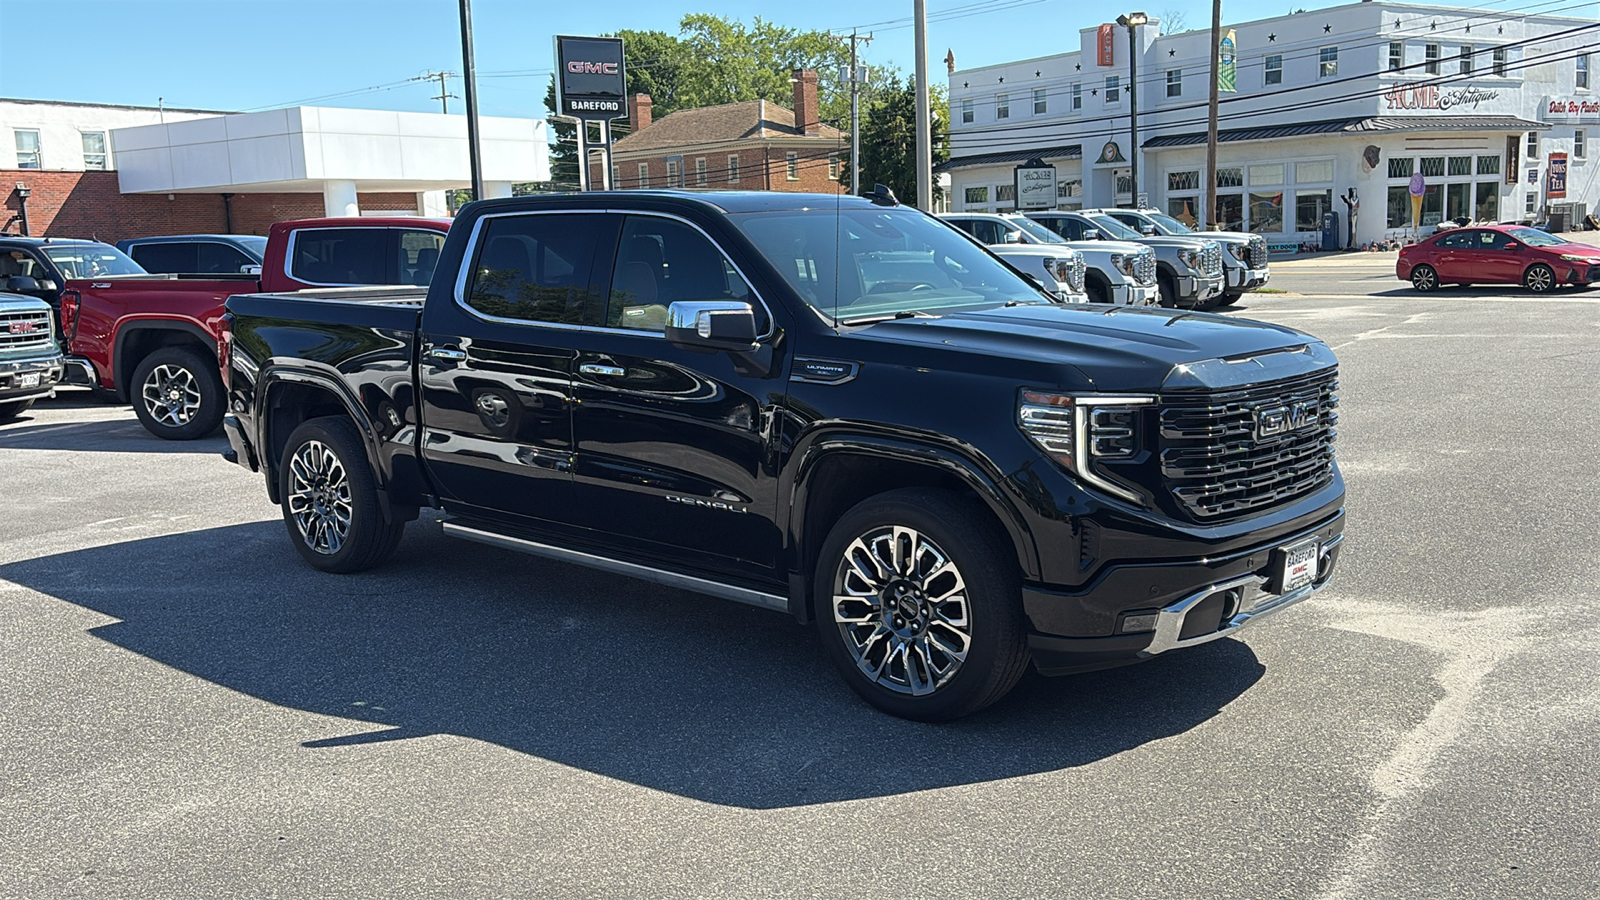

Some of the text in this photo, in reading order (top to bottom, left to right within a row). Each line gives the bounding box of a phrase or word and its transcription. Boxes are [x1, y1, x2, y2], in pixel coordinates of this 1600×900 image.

[568, 61, 618, 75] GMC
[1384, 81, 1499, 111] ACME Antiques
[571, 101, 619, 111] BAREFORD
[1549, 100, 1600, 116] Dutch Boy Paints
[1552, 178, 1564, 190] TEA
[10, 322, 38, 334] GMC
[1260, 402, 1319, 437] GMC
[666, 495, 747, 513] DENALI
[1287, 548, 1315, 568] BAREFORD
[1292, 564, 1308, 576] GMC
